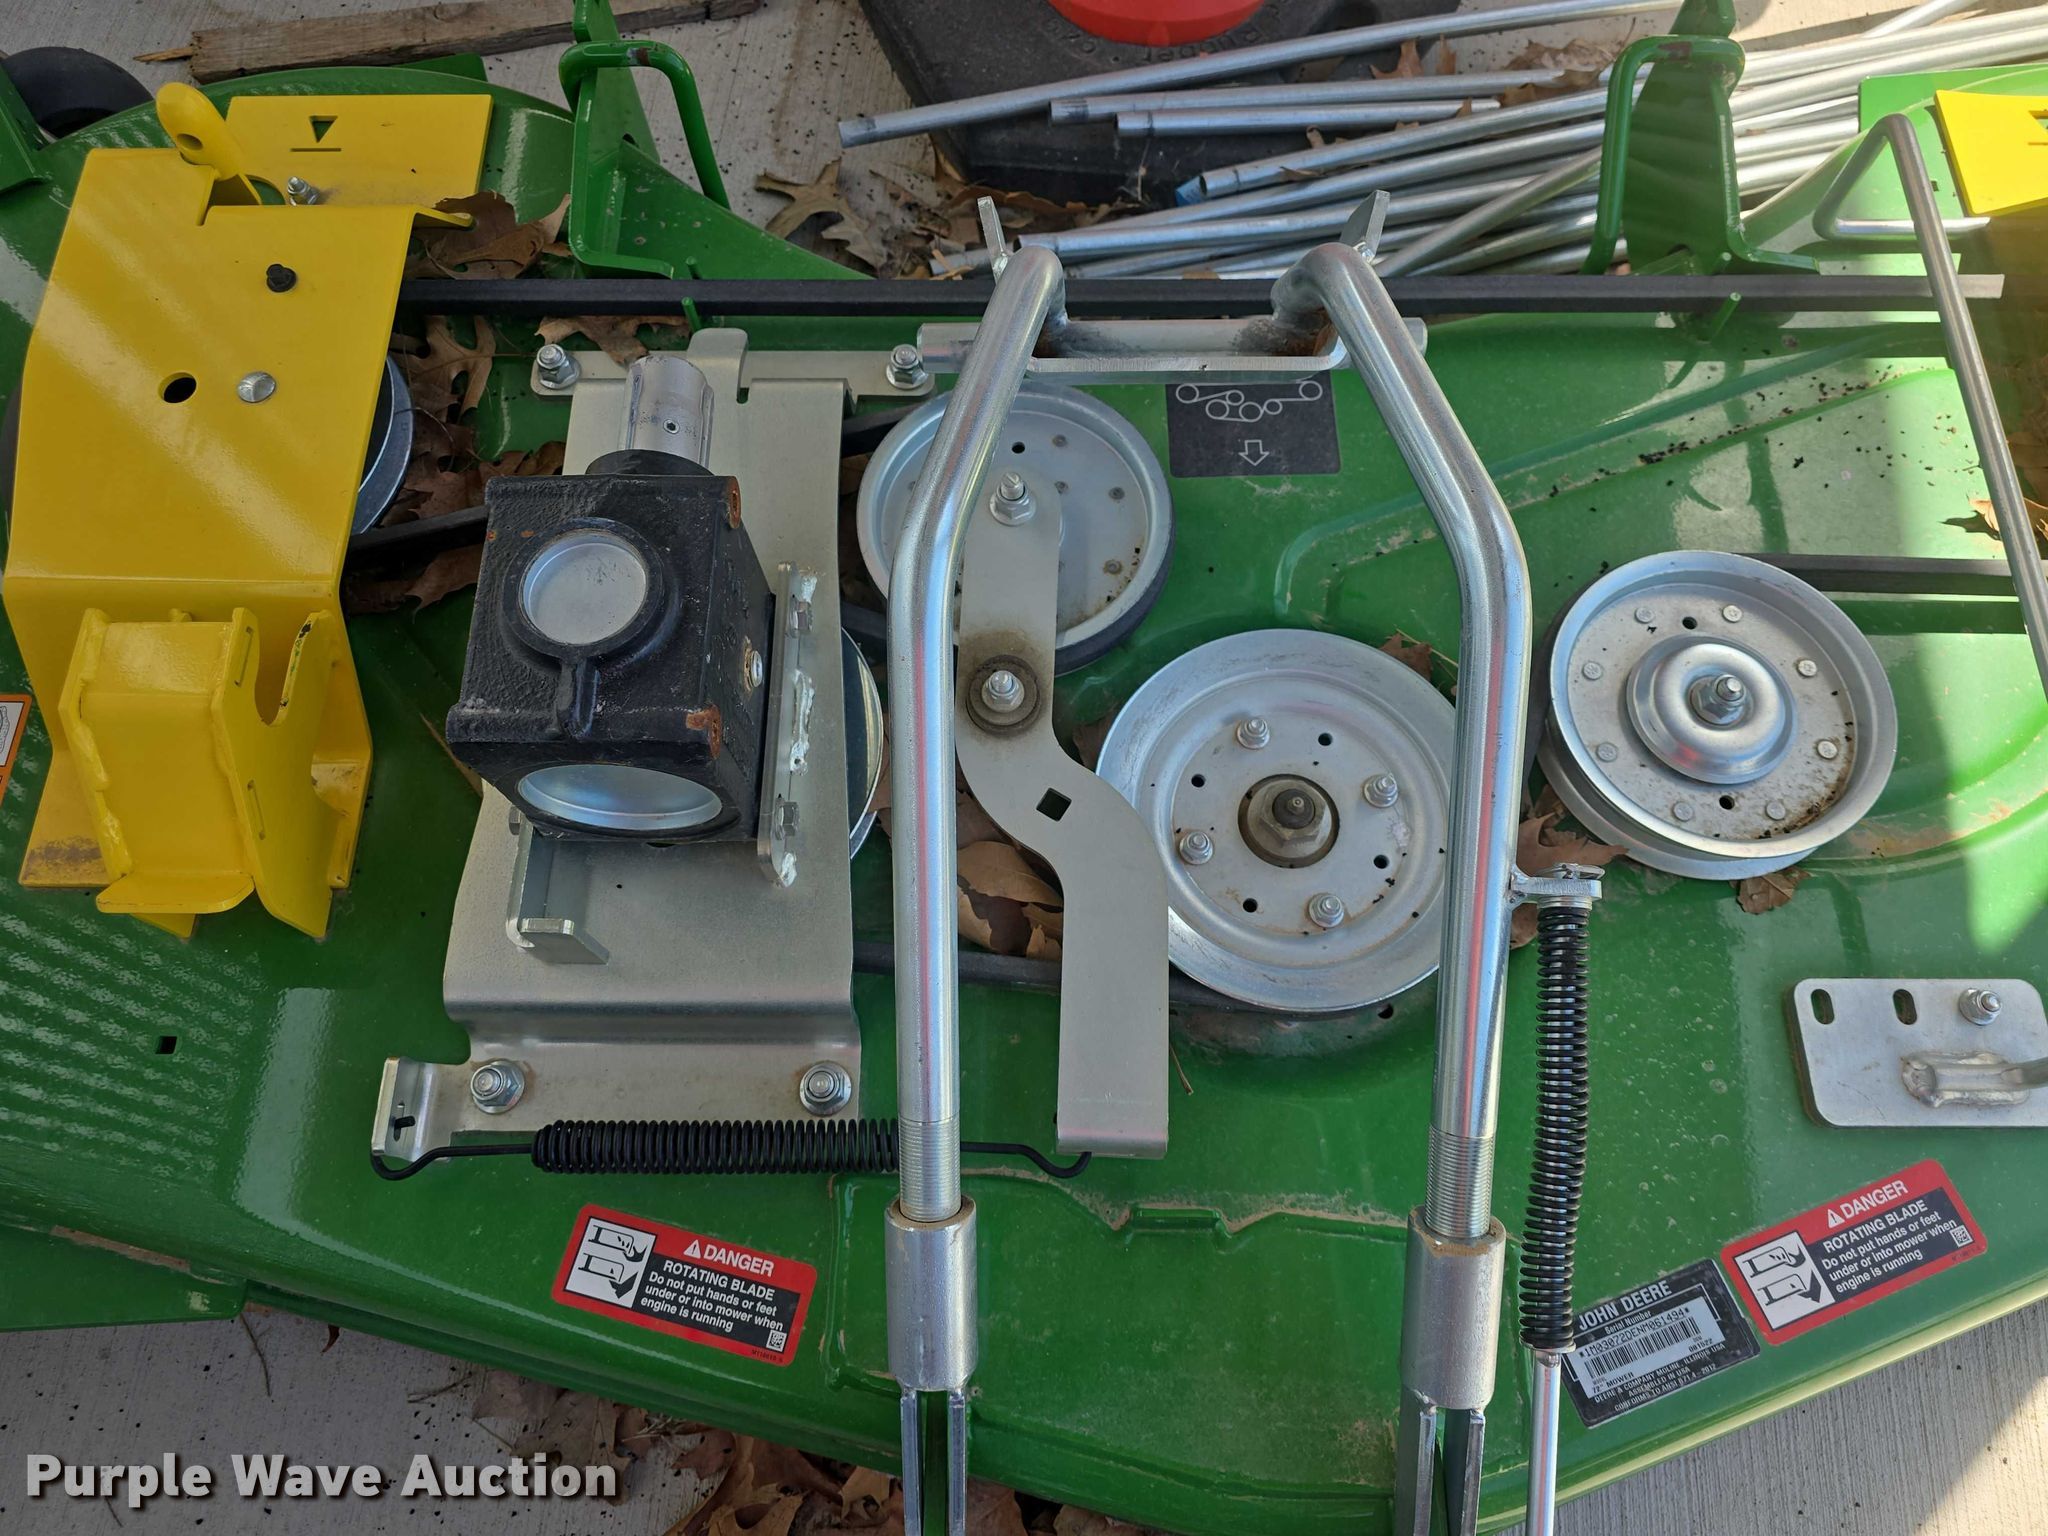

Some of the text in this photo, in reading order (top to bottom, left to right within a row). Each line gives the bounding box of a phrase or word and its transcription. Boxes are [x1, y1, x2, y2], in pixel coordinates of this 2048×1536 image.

[1840, 1179, 1907, 1218] DANGER
[1822, 1211, 1940, 1269] Do not put hands or feet
[1823, 1200, 1927, 1252] ROTATING BLADE
[703, 1245, 774, 1276] DANGER
[1829, 1219, 1956, 1281] under or into mower when
[663, 1261, 774, 1300] ROTATING BLADE
[1835, 1248, 1922, 1294] engine is running
[645, 1284, 782, 1330] under or into mower when
[648, 1271, 776, 1315] Do not put hands or feet
[1577, 1280, 1671, 1330] JOHN DEERE
[640, 1296, 732, 1332] engine is running
[1605, 1310, 1651, 1334] Serial Number
[1607, 1371, 1633, 1387] MOWER
[1624, 1372, 1655, 1390] COMPANY
[1684, 1349, 1710, 1364] ILLINOIS
[1710, 1342, 1725, 1353] USA
[1628, 1365, 1690, 1396] ASSEMBLED IN USA
[1615, 1391, 1651, 1411] CONFORMS
[1650, 1386, 1661, 1396] TO
